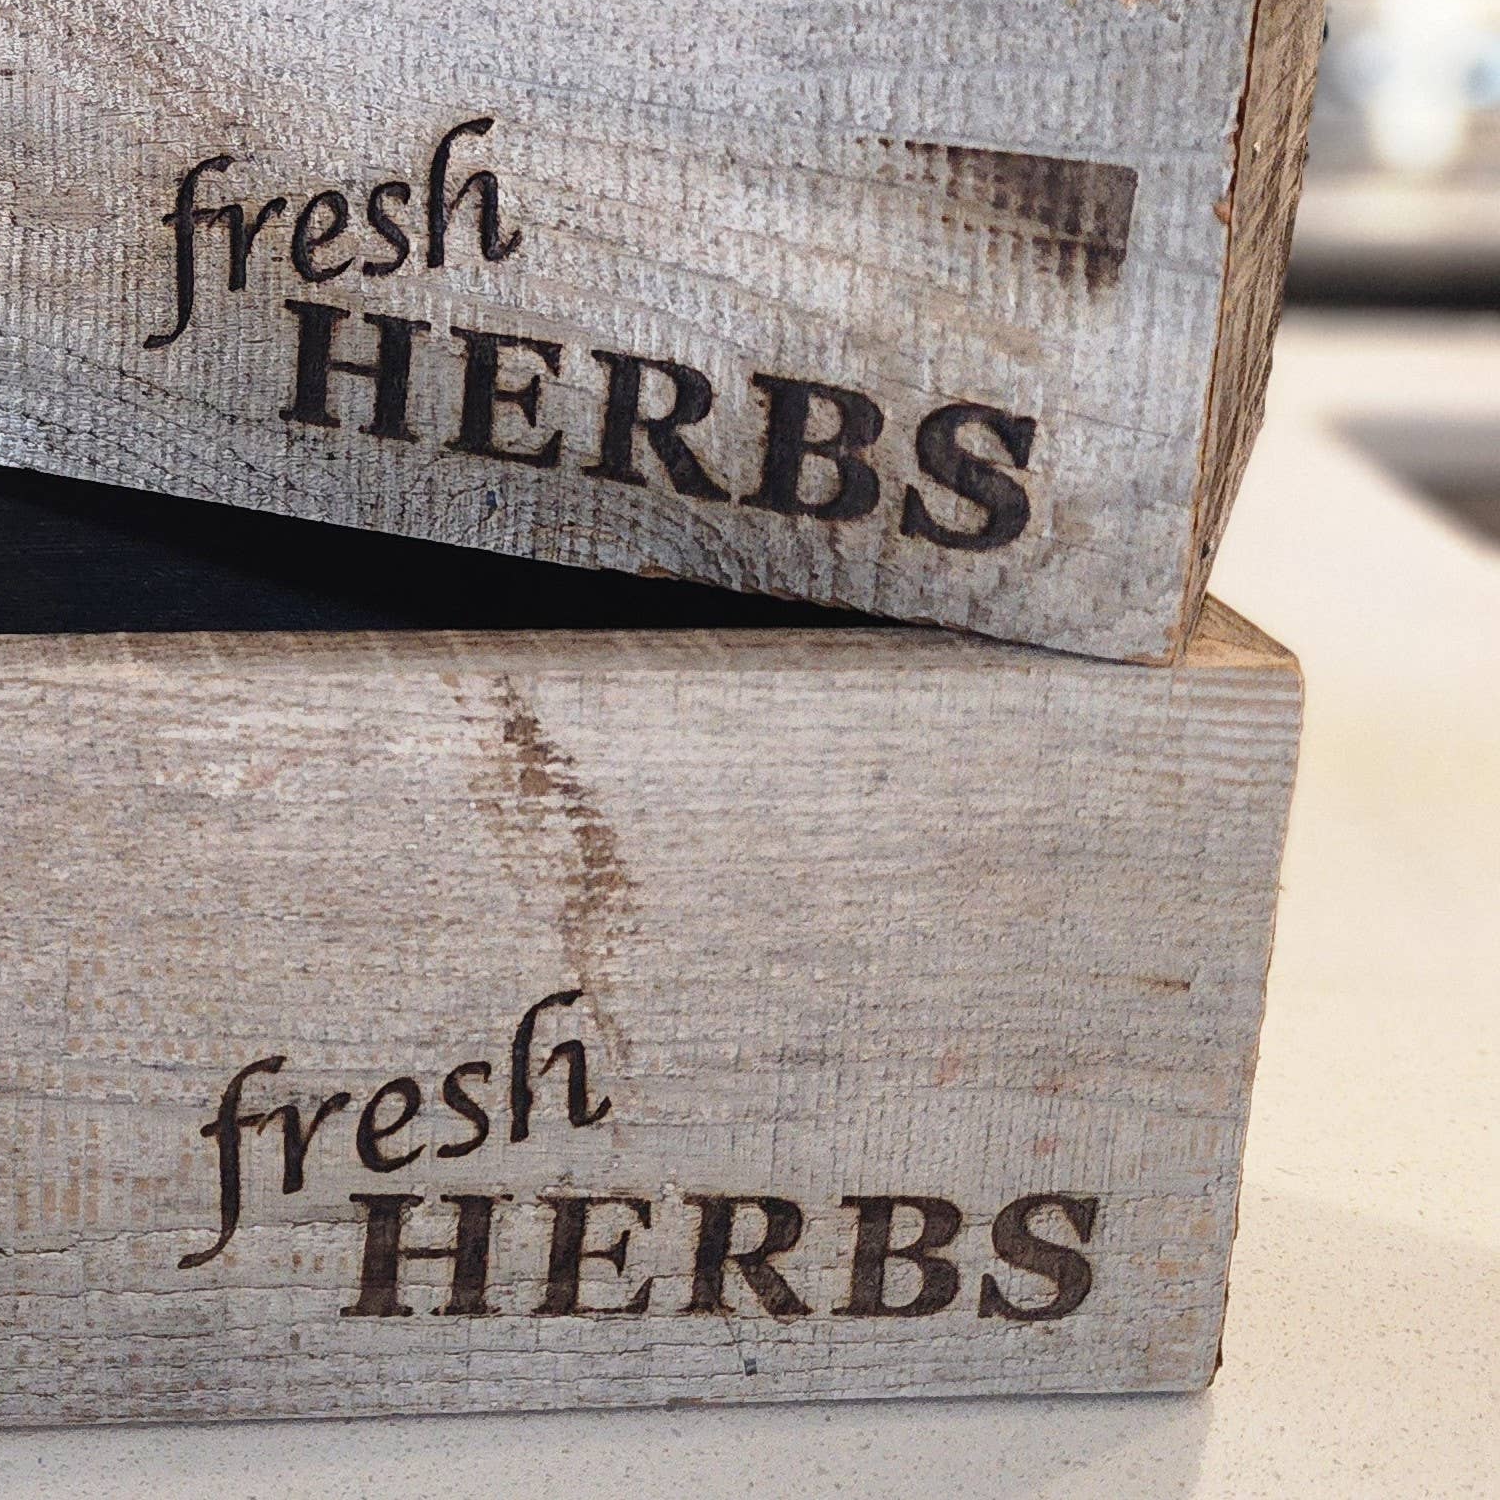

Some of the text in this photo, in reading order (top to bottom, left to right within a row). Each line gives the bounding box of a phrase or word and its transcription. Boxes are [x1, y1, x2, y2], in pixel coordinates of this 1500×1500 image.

[145, 117, 522, 348] fresh
[279, 299, 1037, 551] HERBS
[178, 989, 612, 1269] fresh
[339, 1192, 1101, 1321] HERBS
